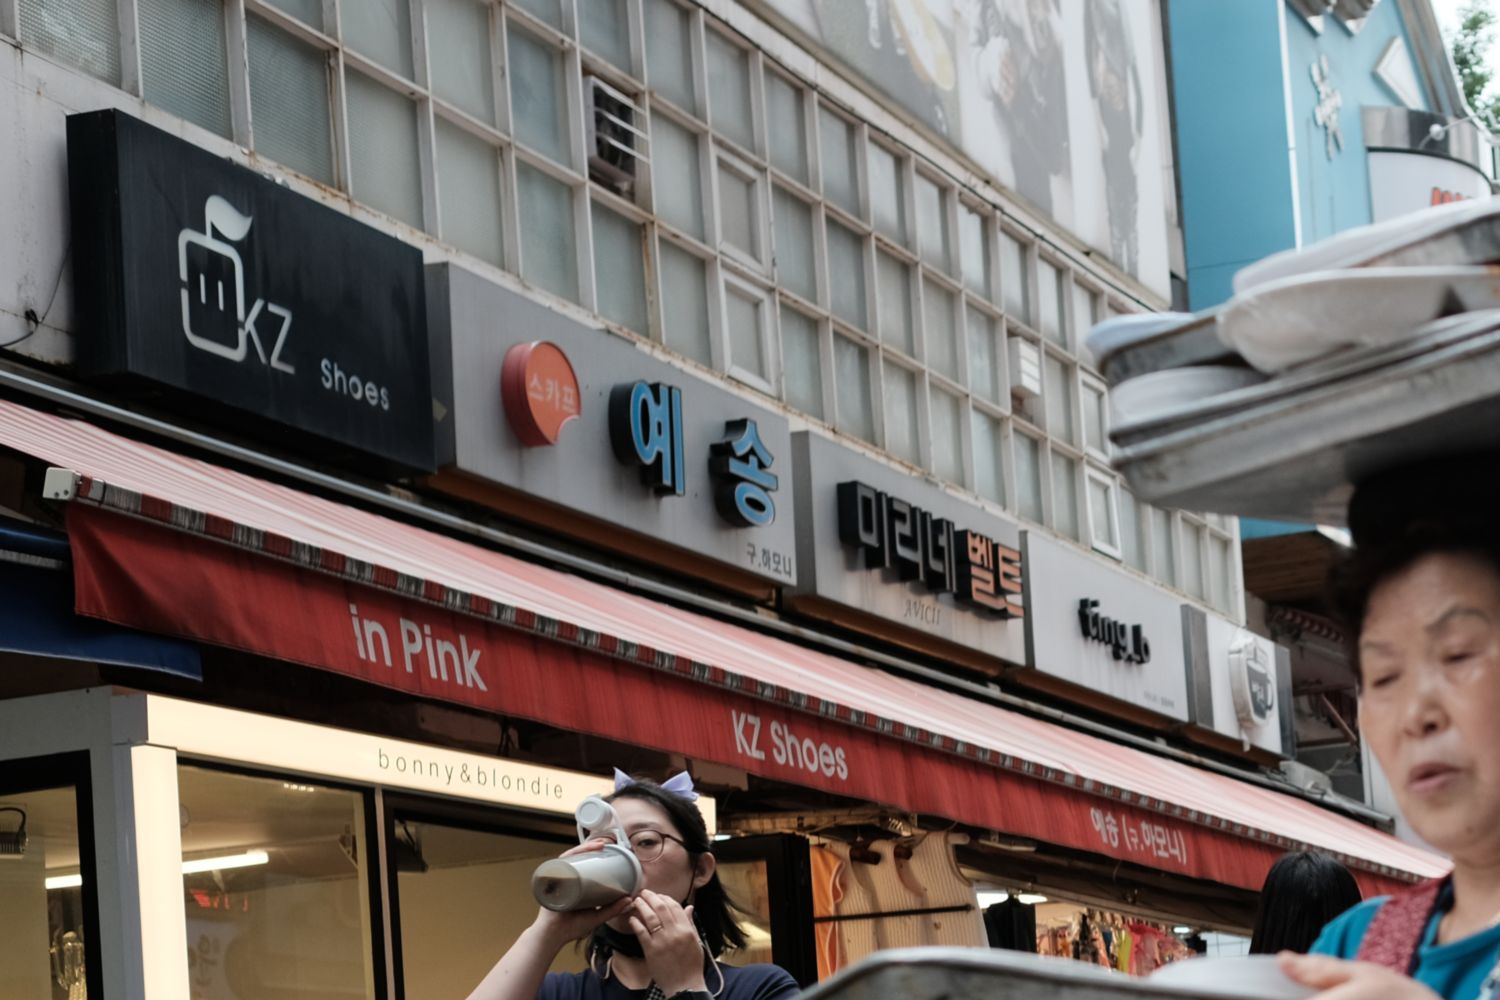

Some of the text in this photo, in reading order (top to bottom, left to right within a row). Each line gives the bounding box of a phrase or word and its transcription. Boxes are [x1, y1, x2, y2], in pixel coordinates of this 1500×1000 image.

[320, 357, 390, 411] Shoes
[529, 377, 577, 413] 스카프
[349, 604, 488, 692] in Pink
[731, 709, 849, 780] KZ Shoes
[378, 748, 563, 799] bonny&blondie
[1090, 807, 1119, 849] 예송
